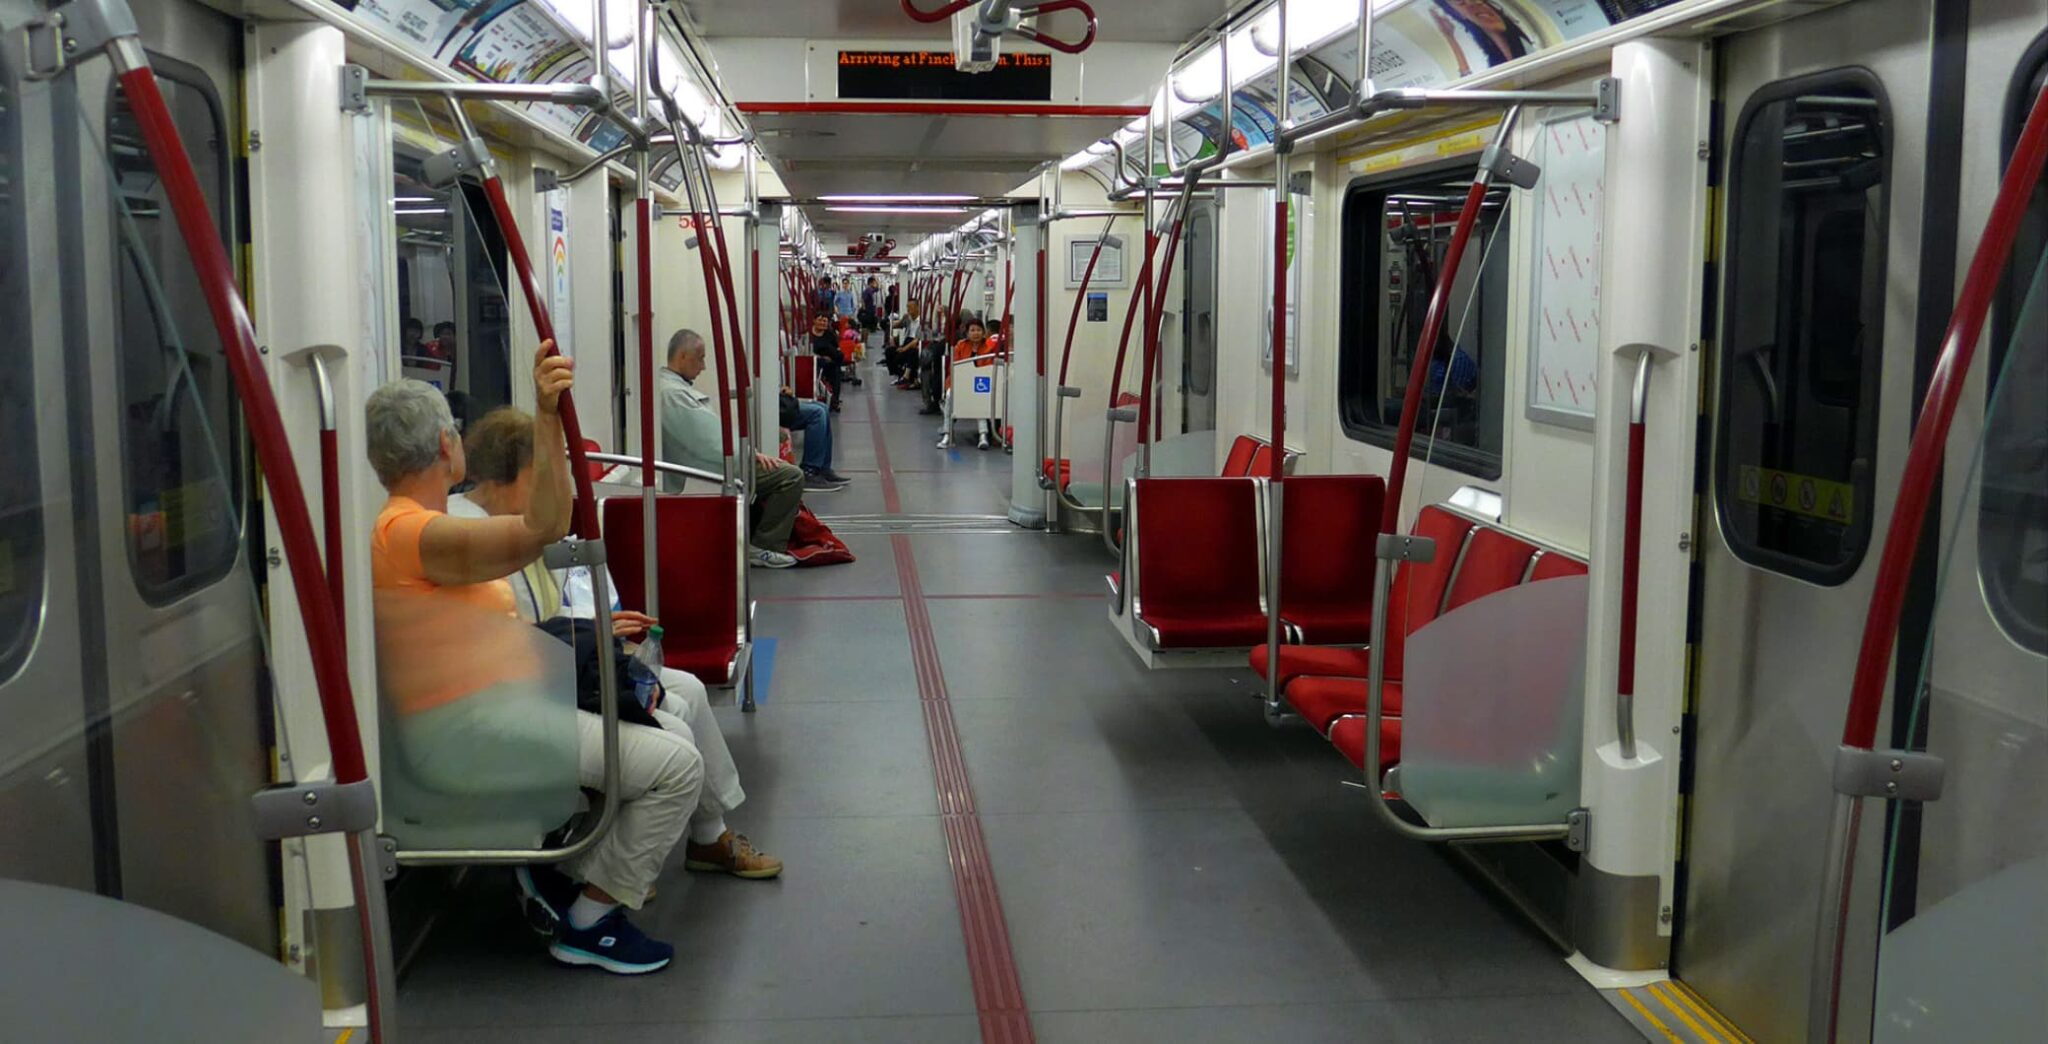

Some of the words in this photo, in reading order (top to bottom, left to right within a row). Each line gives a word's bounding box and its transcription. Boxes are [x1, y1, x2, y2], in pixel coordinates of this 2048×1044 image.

[839, 52, 901, 67] Arriving
[903, 53, 916, 65] at
[1013, 52, 1043, 66] This
